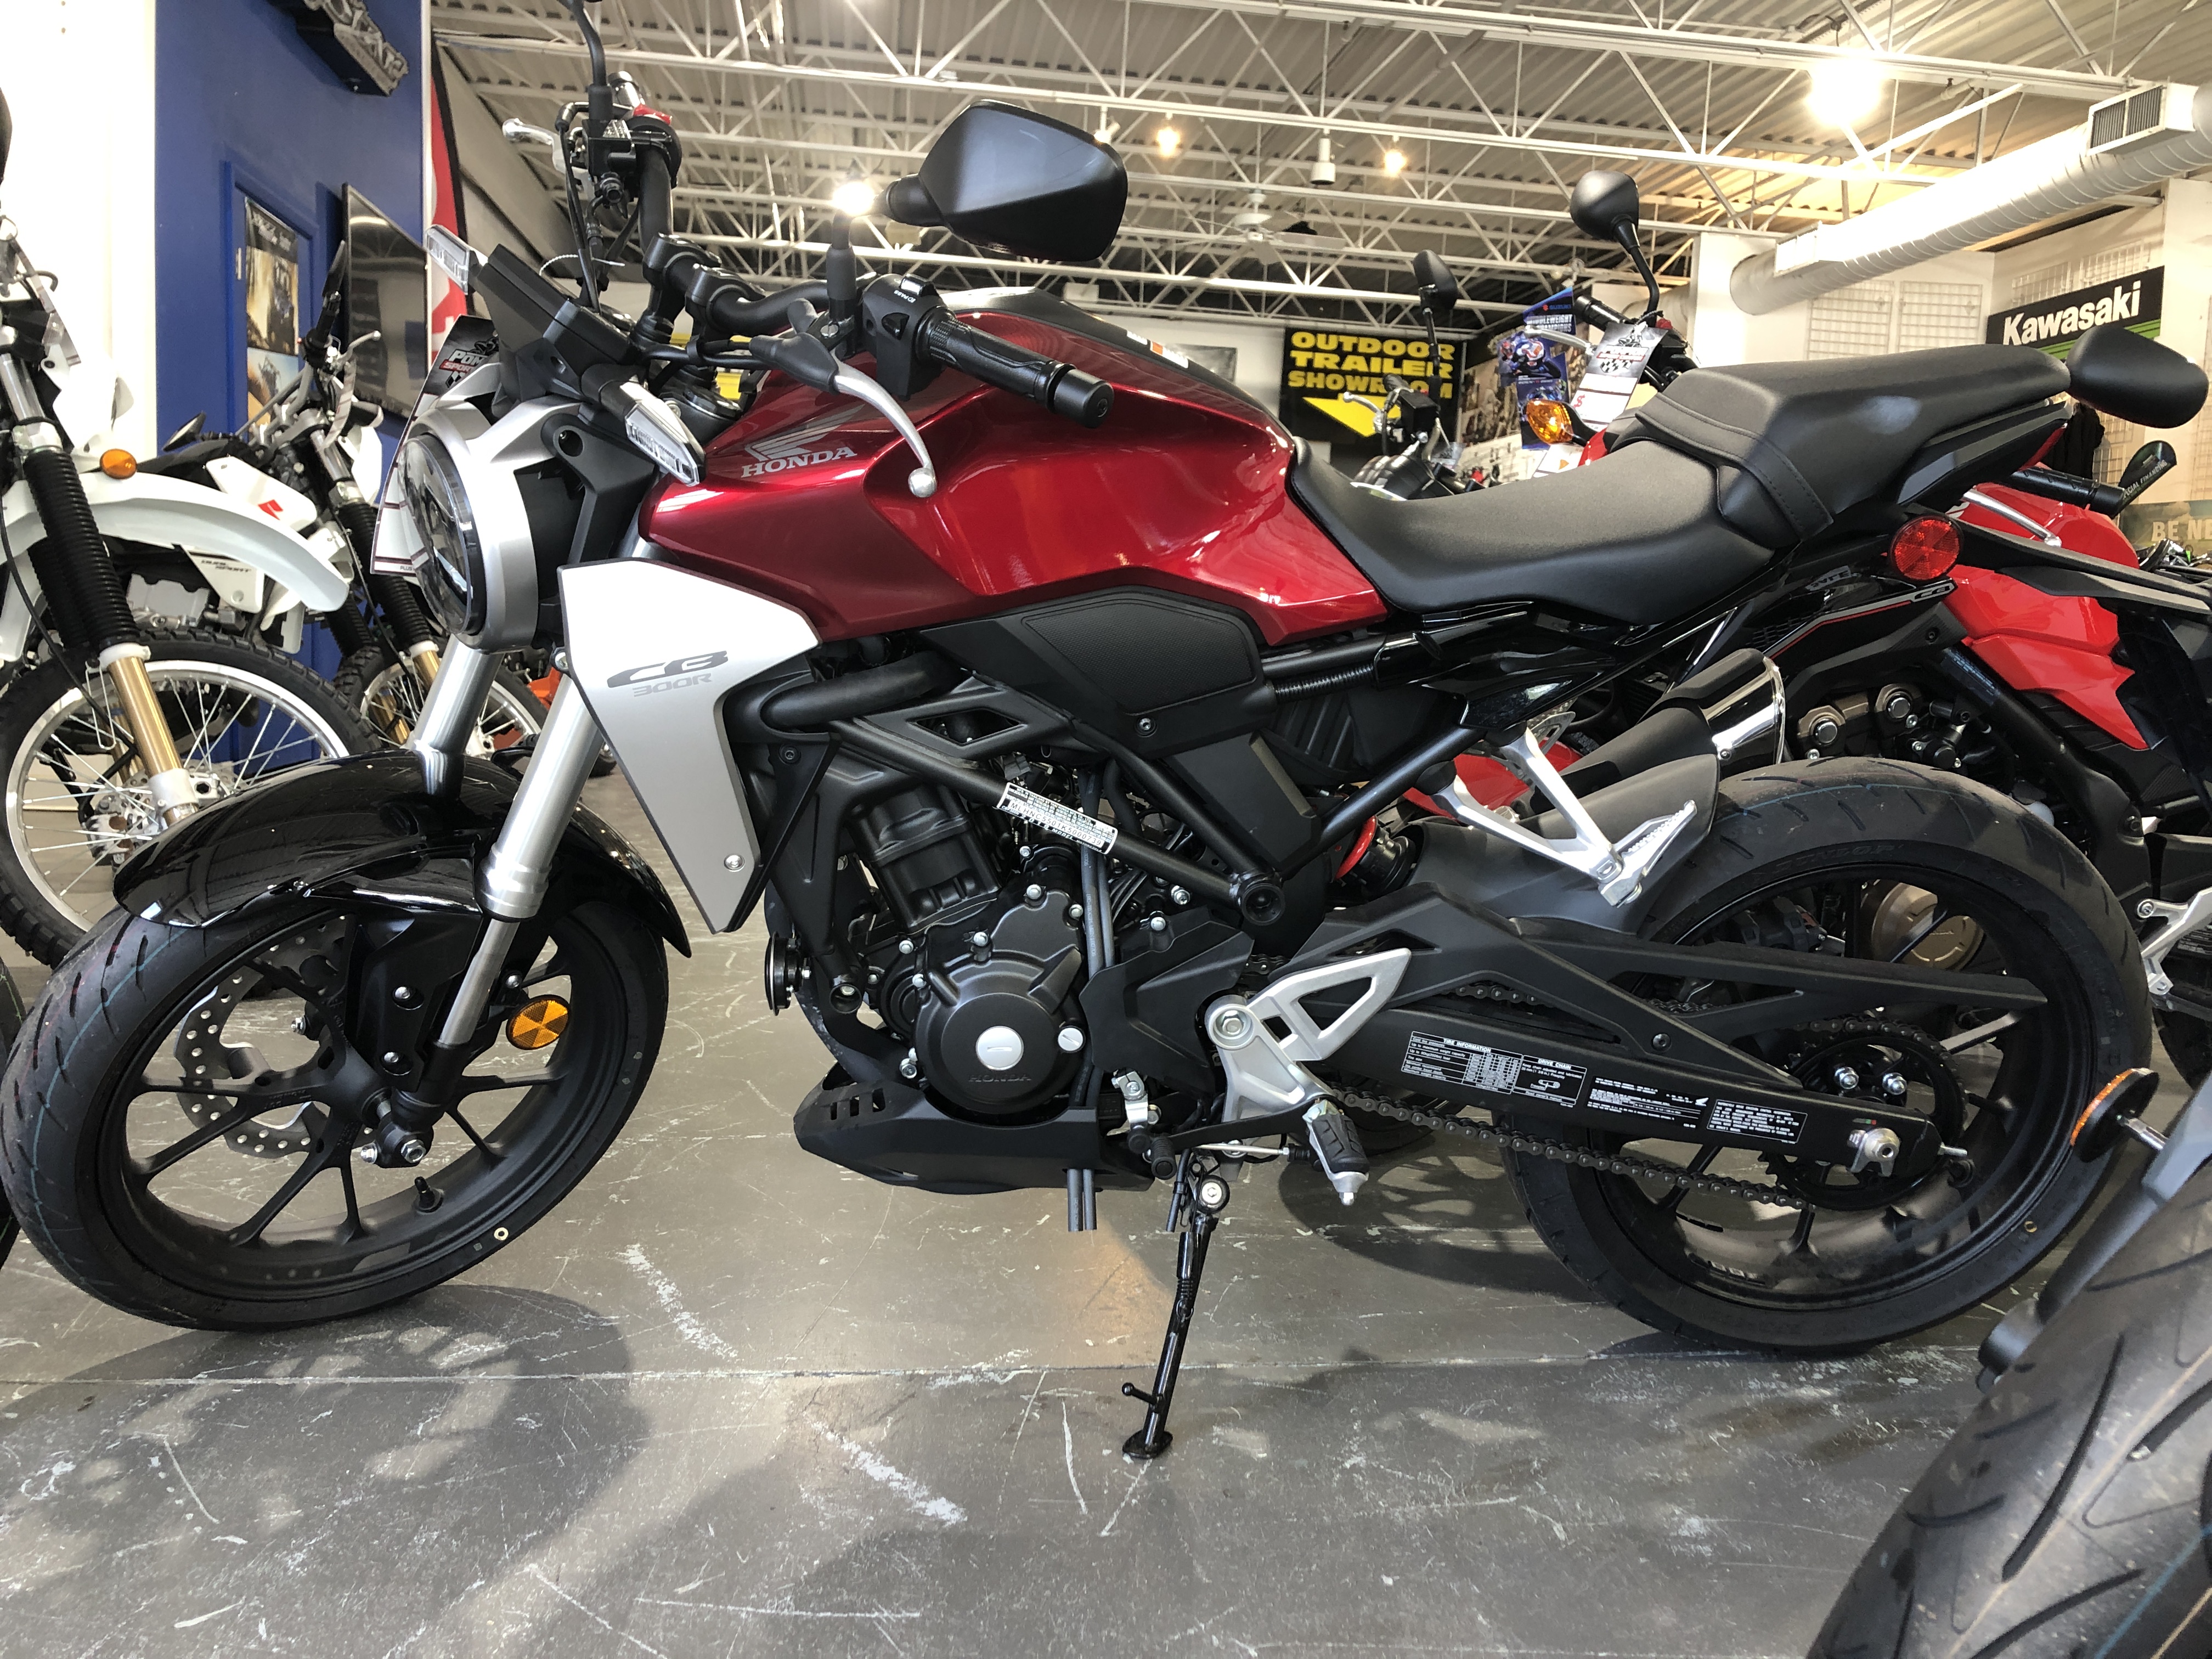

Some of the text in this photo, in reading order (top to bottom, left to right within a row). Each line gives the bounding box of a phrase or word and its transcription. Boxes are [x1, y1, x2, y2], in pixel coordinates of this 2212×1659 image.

[2002, 280, 2141, 346] Kawasaki
[1291, 331, 1455, 360] OUTDOOR
[1290, 350, 1453, 379] TRAILER
[741, 445, 857, 479] HONDA
[2151, 521, 2179, 541] BE
[607, 650, 729, 689] CB
[632, 673, 713, 697] 300R
[1010, 802, 1102, 847] MLHNC5501K5000739
[1457, 1042, 1491, 1053] INFORMATION
[1555, 1062, 1572, 1070] CHAIN
